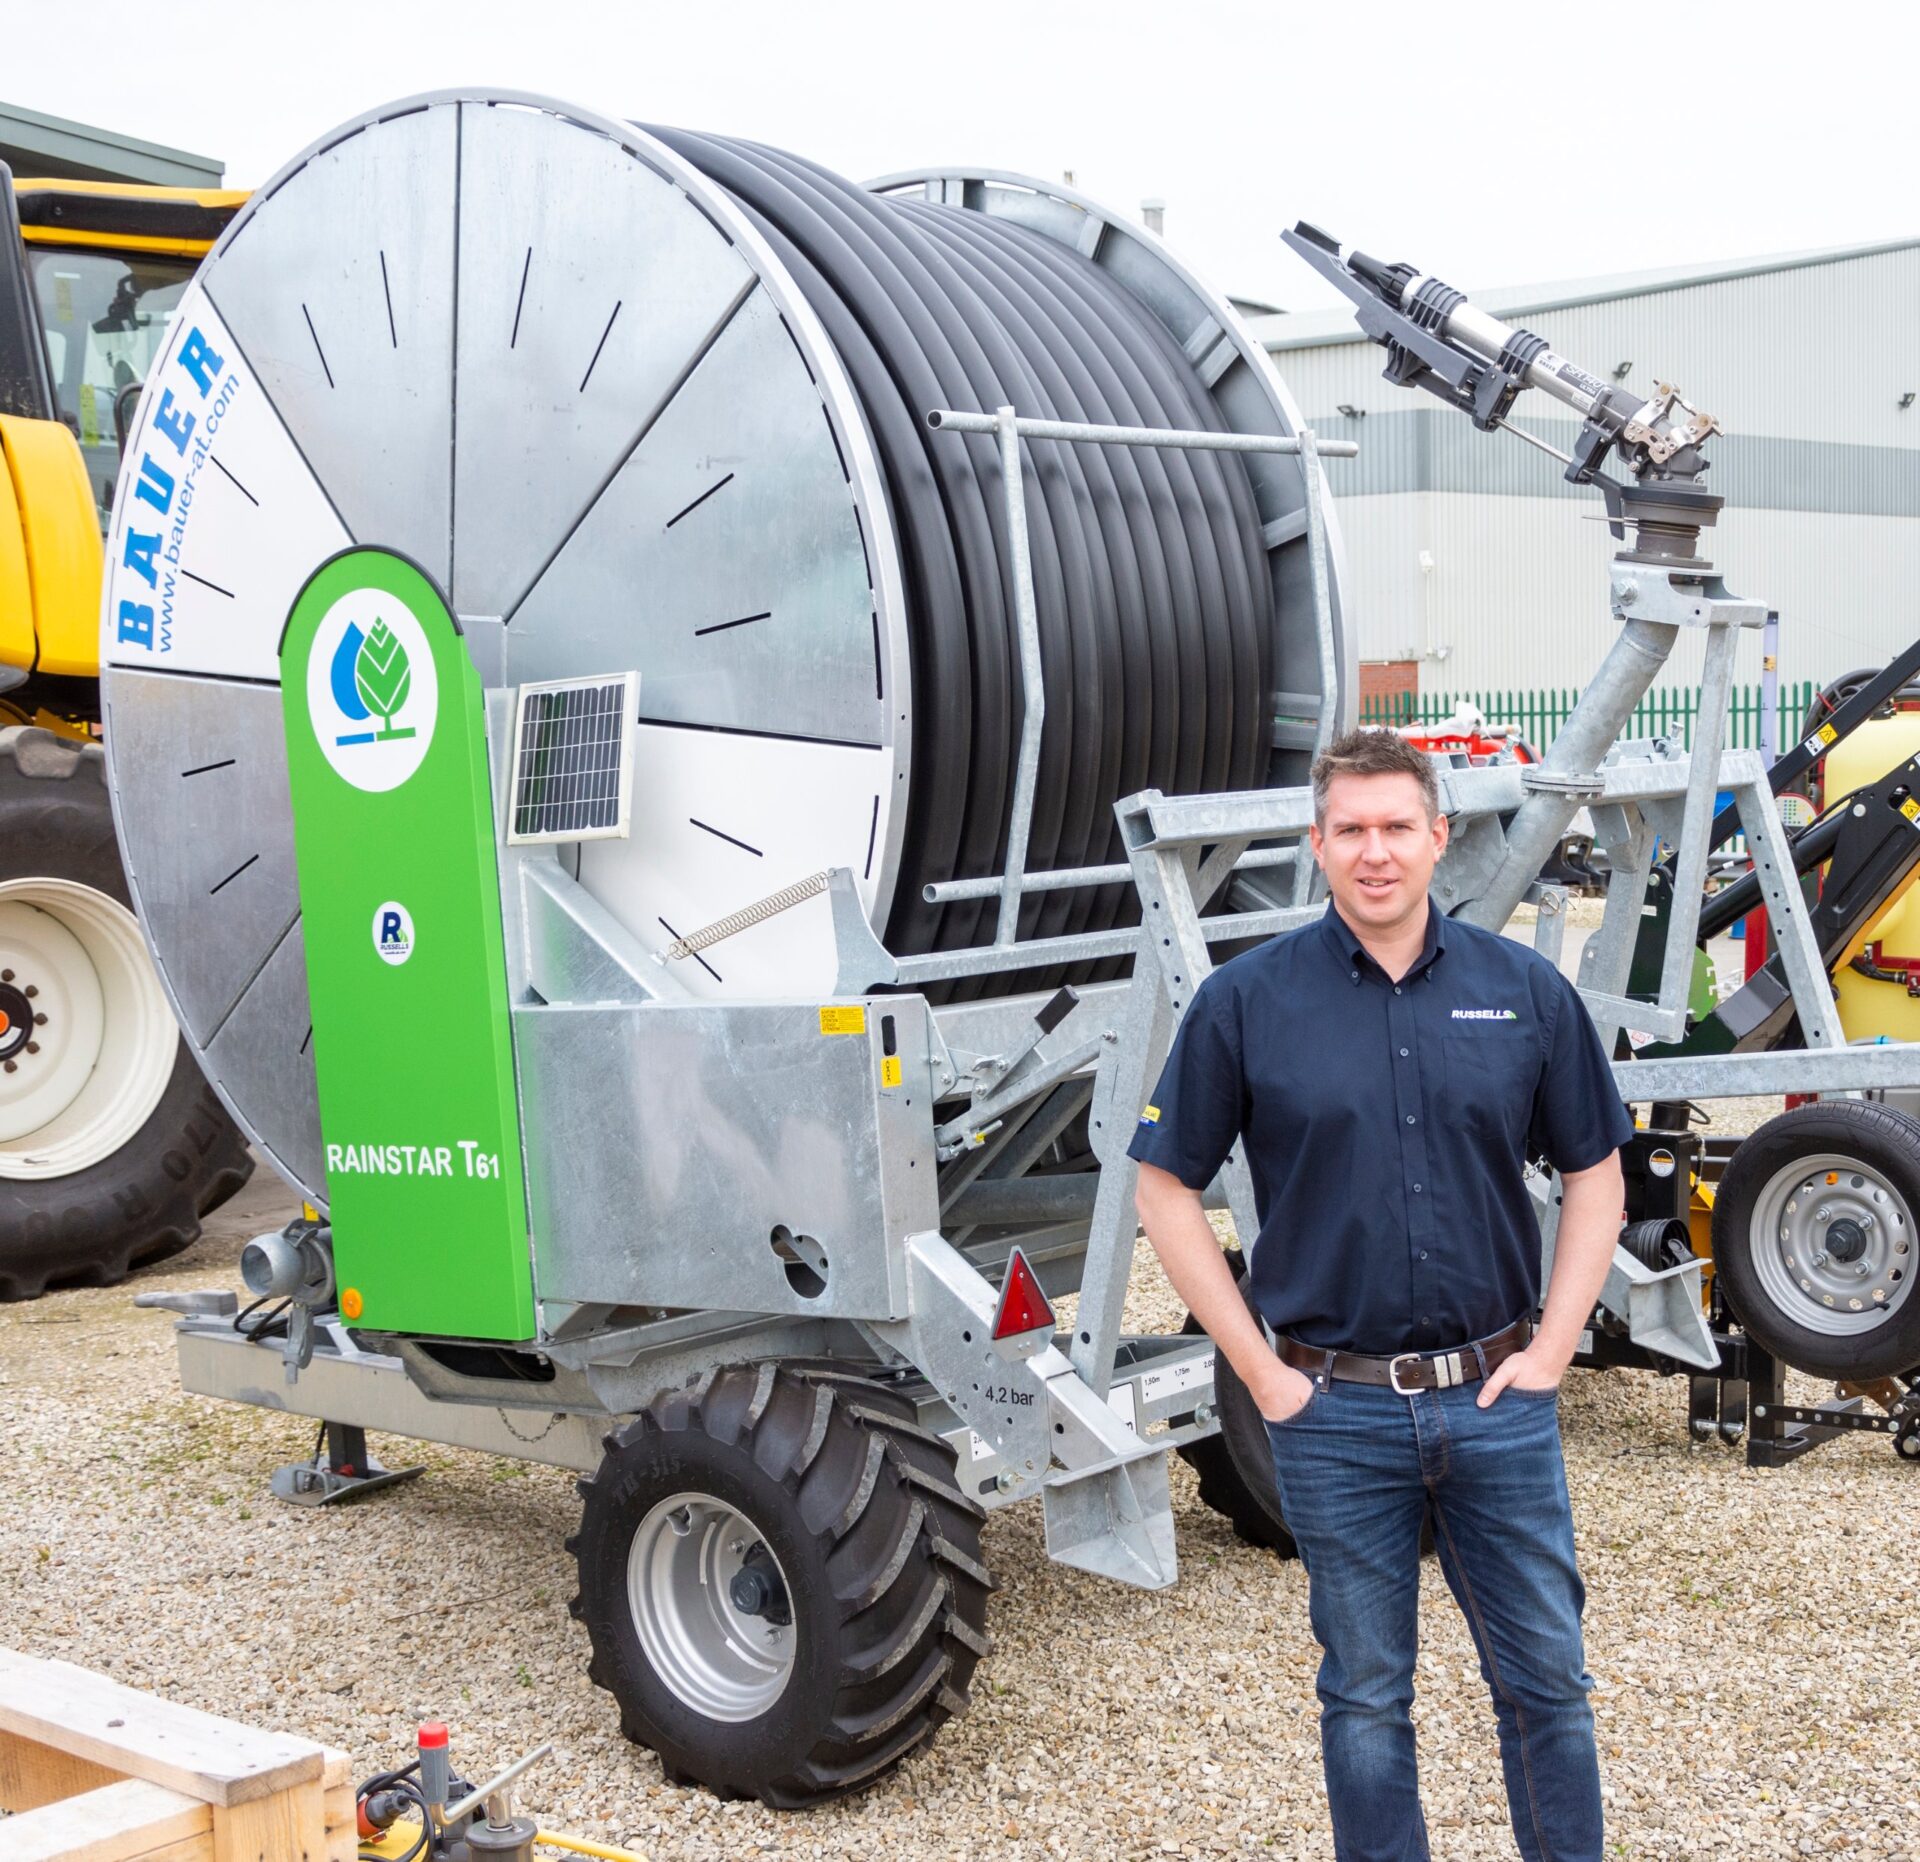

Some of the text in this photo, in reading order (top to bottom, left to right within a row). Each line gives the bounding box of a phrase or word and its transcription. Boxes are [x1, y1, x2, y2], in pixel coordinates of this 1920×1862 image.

[117, 326, 225, 652] BAUER
[160, 373, 240, 653] www.bauer-at.com
[381, 911, 402, 943] R
[1451, 1009, 1511, 1020] RUSSELLS
[326, 1140, 500, 1180] RAINSTAR T61
[1174, 1367, 1191, 1378] 1,75m
[1203, 1359, 1216, 1369] 2,00
[1144, 1376, 1161, 1387] 1,50m
[985, 1385, 1035, 1407] 4,2 bar
